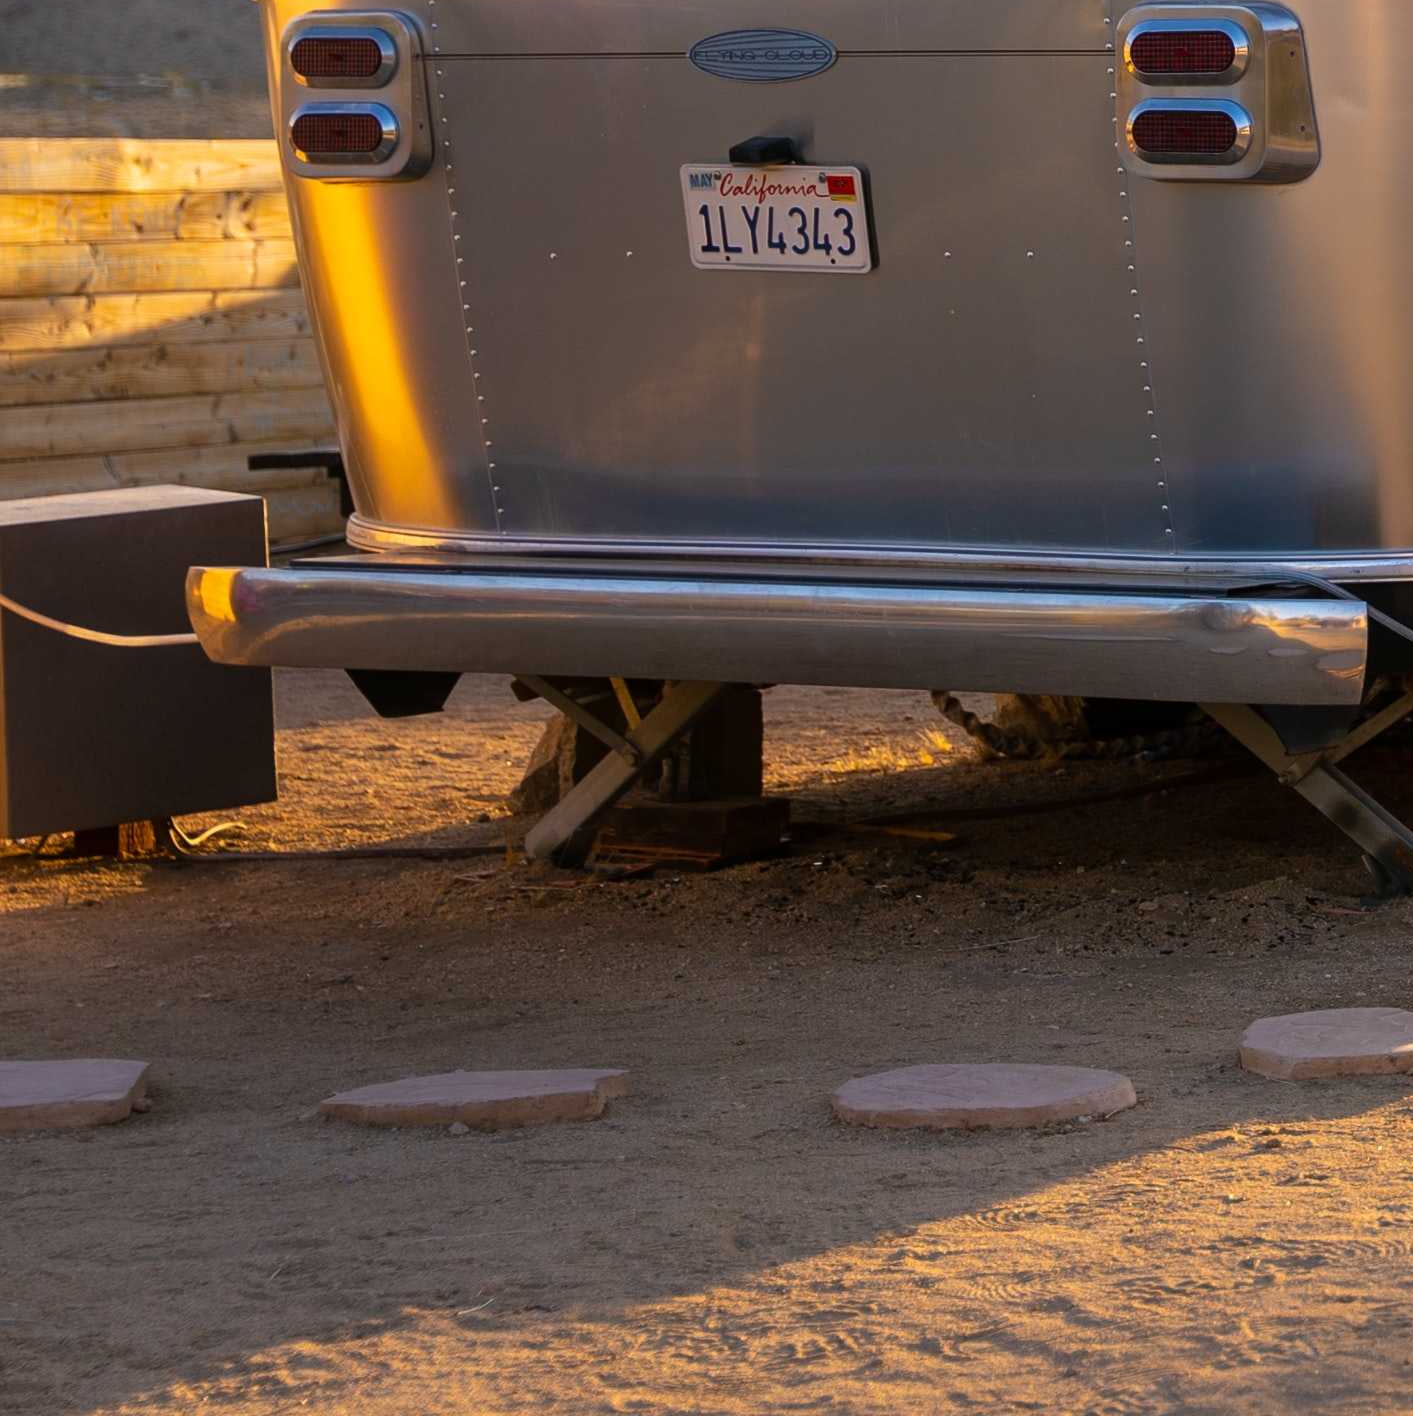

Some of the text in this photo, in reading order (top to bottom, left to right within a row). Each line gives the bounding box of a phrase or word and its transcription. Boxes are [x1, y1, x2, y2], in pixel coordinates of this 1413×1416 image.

[689, 173, 713, 188] MAY
[719, 172, 831, 204] California
[698, 203, 856, 256] 1LY4343
